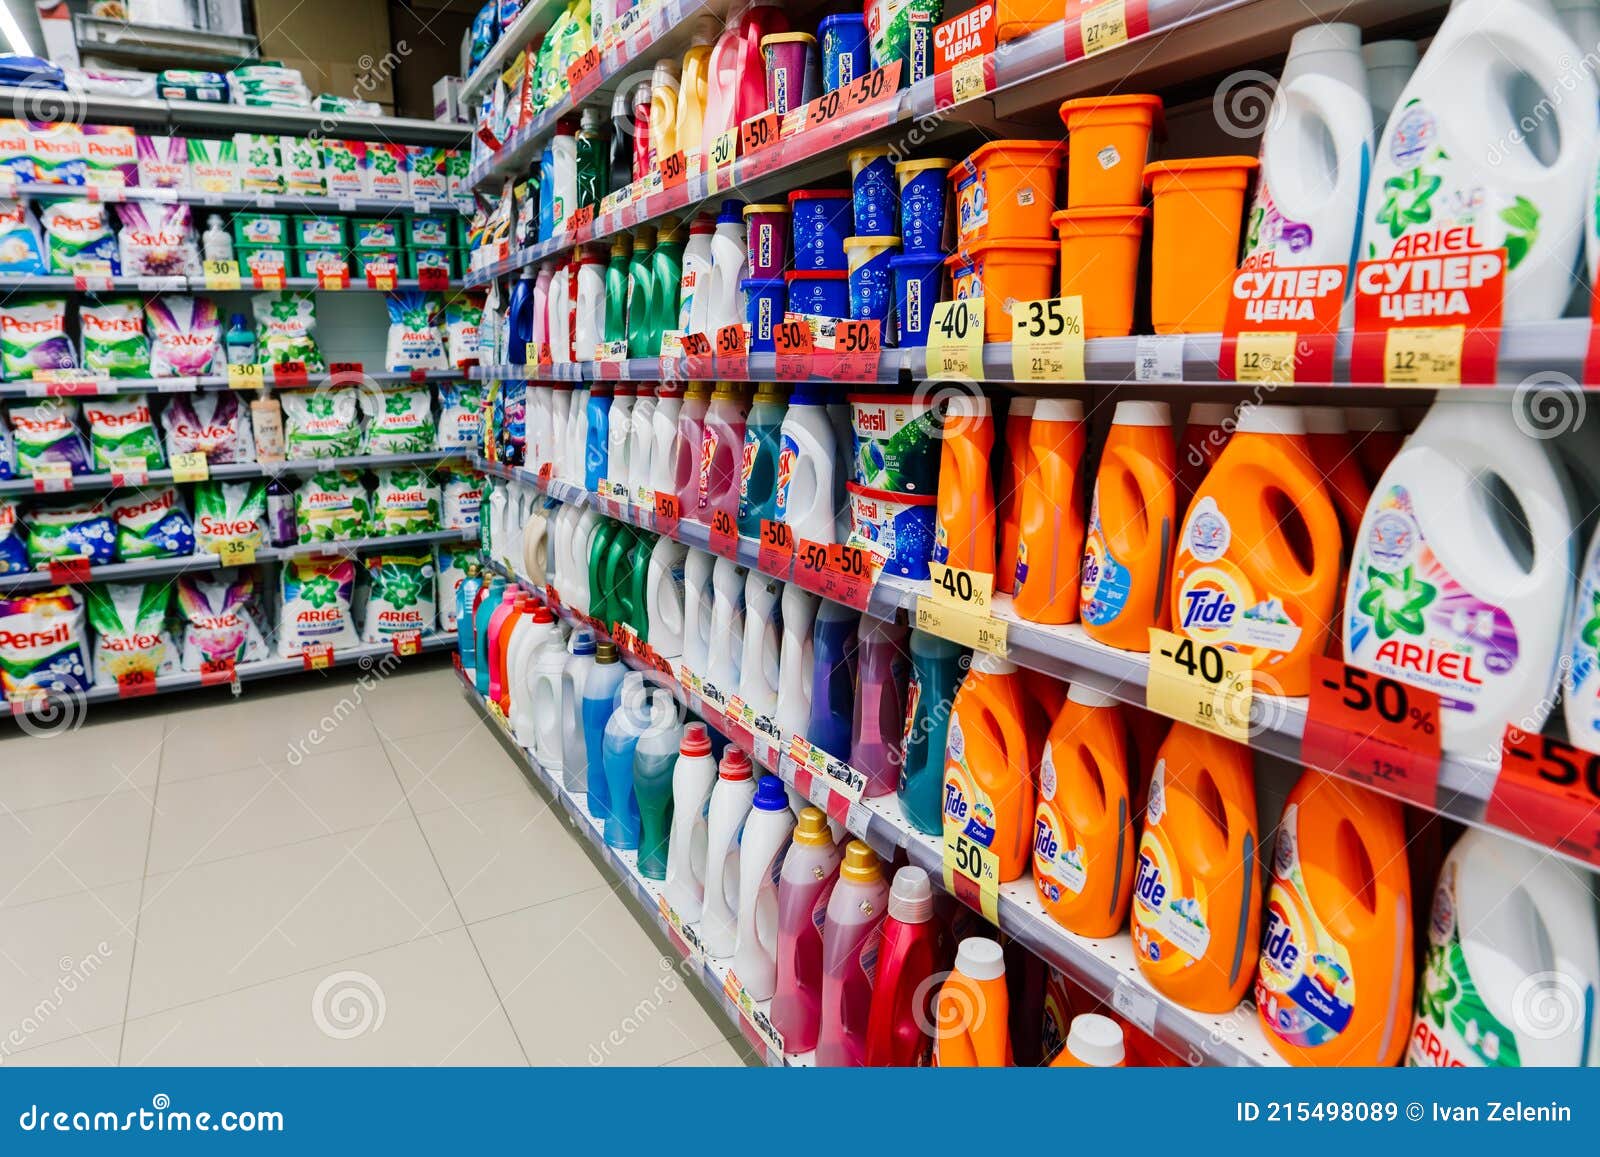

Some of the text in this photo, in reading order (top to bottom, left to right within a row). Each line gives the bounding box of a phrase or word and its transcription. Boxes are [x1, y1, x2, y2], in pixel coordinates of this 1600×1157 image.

[911, 12, 929, 20] Persil
[934, 5, 993, 49] СУПЕР
[1087, 24, 1099, 42] 27
[945, 32, 983, 62] ЦЕНА
[851, 68, 891, 104] -50%
[811, 91, 845, 124] -50%
[745, 117, 775, 148] -50%
[34, 138, 80, 155] Persil
[88, 142, 133, 157] Persil
[143, 162, 182, 174] Savex
[195, 165, 233, 177] Savex
[131, 231, 185, 247] Savex
[1390, 226, 1484, 260] ARIEL
[1232, 268, 1344, 299] СУПЕР
[1357, 254, 1502, 296] СУПЕР
[1017, 299, 1080, 338] -35%
[1245, 299, 1315, 323] ЦЕНА
[1380, 290, 1471, 320] ЦЕНА
[1, 314, 64, 333] Persil
[82, 313, 143, 333] Persil
[934, 301, 980, 339] -40%
[158, 332, 214, 348] Savex
[719, 327, 743, 351] -50%
[777, 322, 808, 349] -50%
[839, 323, 877, 351] -50%
[1243, 352, 1260, 369] 12
[1395, 351, 1416, 370] 12
[88, 404, 151, 427] Persil
[383, 413, 420, 424] ARIEL
[858, 408, 886, 431] Persil
[176, 424, 236, 440] Savex
[113, 489, 174, 523] Persil
[386, 492, 427, 502] ARIEL
[857, 499, 878, 519] Persil
[201, 516, 260, 535] Savex
[763, 519, 793, 550] -50%
[834, 548, 870, 579] -50%
[934, 567, 985, 606] -40%
[296, 609, 343, 622] ARIEL
[378, 609, 423, 622] ARIEL
[1183, 590, 1237, 628] Tide
[0, 622, 70, 650] Persil
[101, 633, 163, 652] Savex
[1160, 639, 1244, 693] -40%
[1375, 640, 1483, 685] ARIEL
[1198, 701, 1213, 718] 10
[1322, 665, 1436, 735] -50%
[944, 783, 968, 818] Tide
[971, 825, 988, 840] Color
[1033, 818, 1059, 859] Tide
[948, 836, 993, 879] -50%
[1134, 851, 1166, 907] Tide
[1262, 912, 1299, 969] Tide
[1304, 990, 1335, 1018] Color
